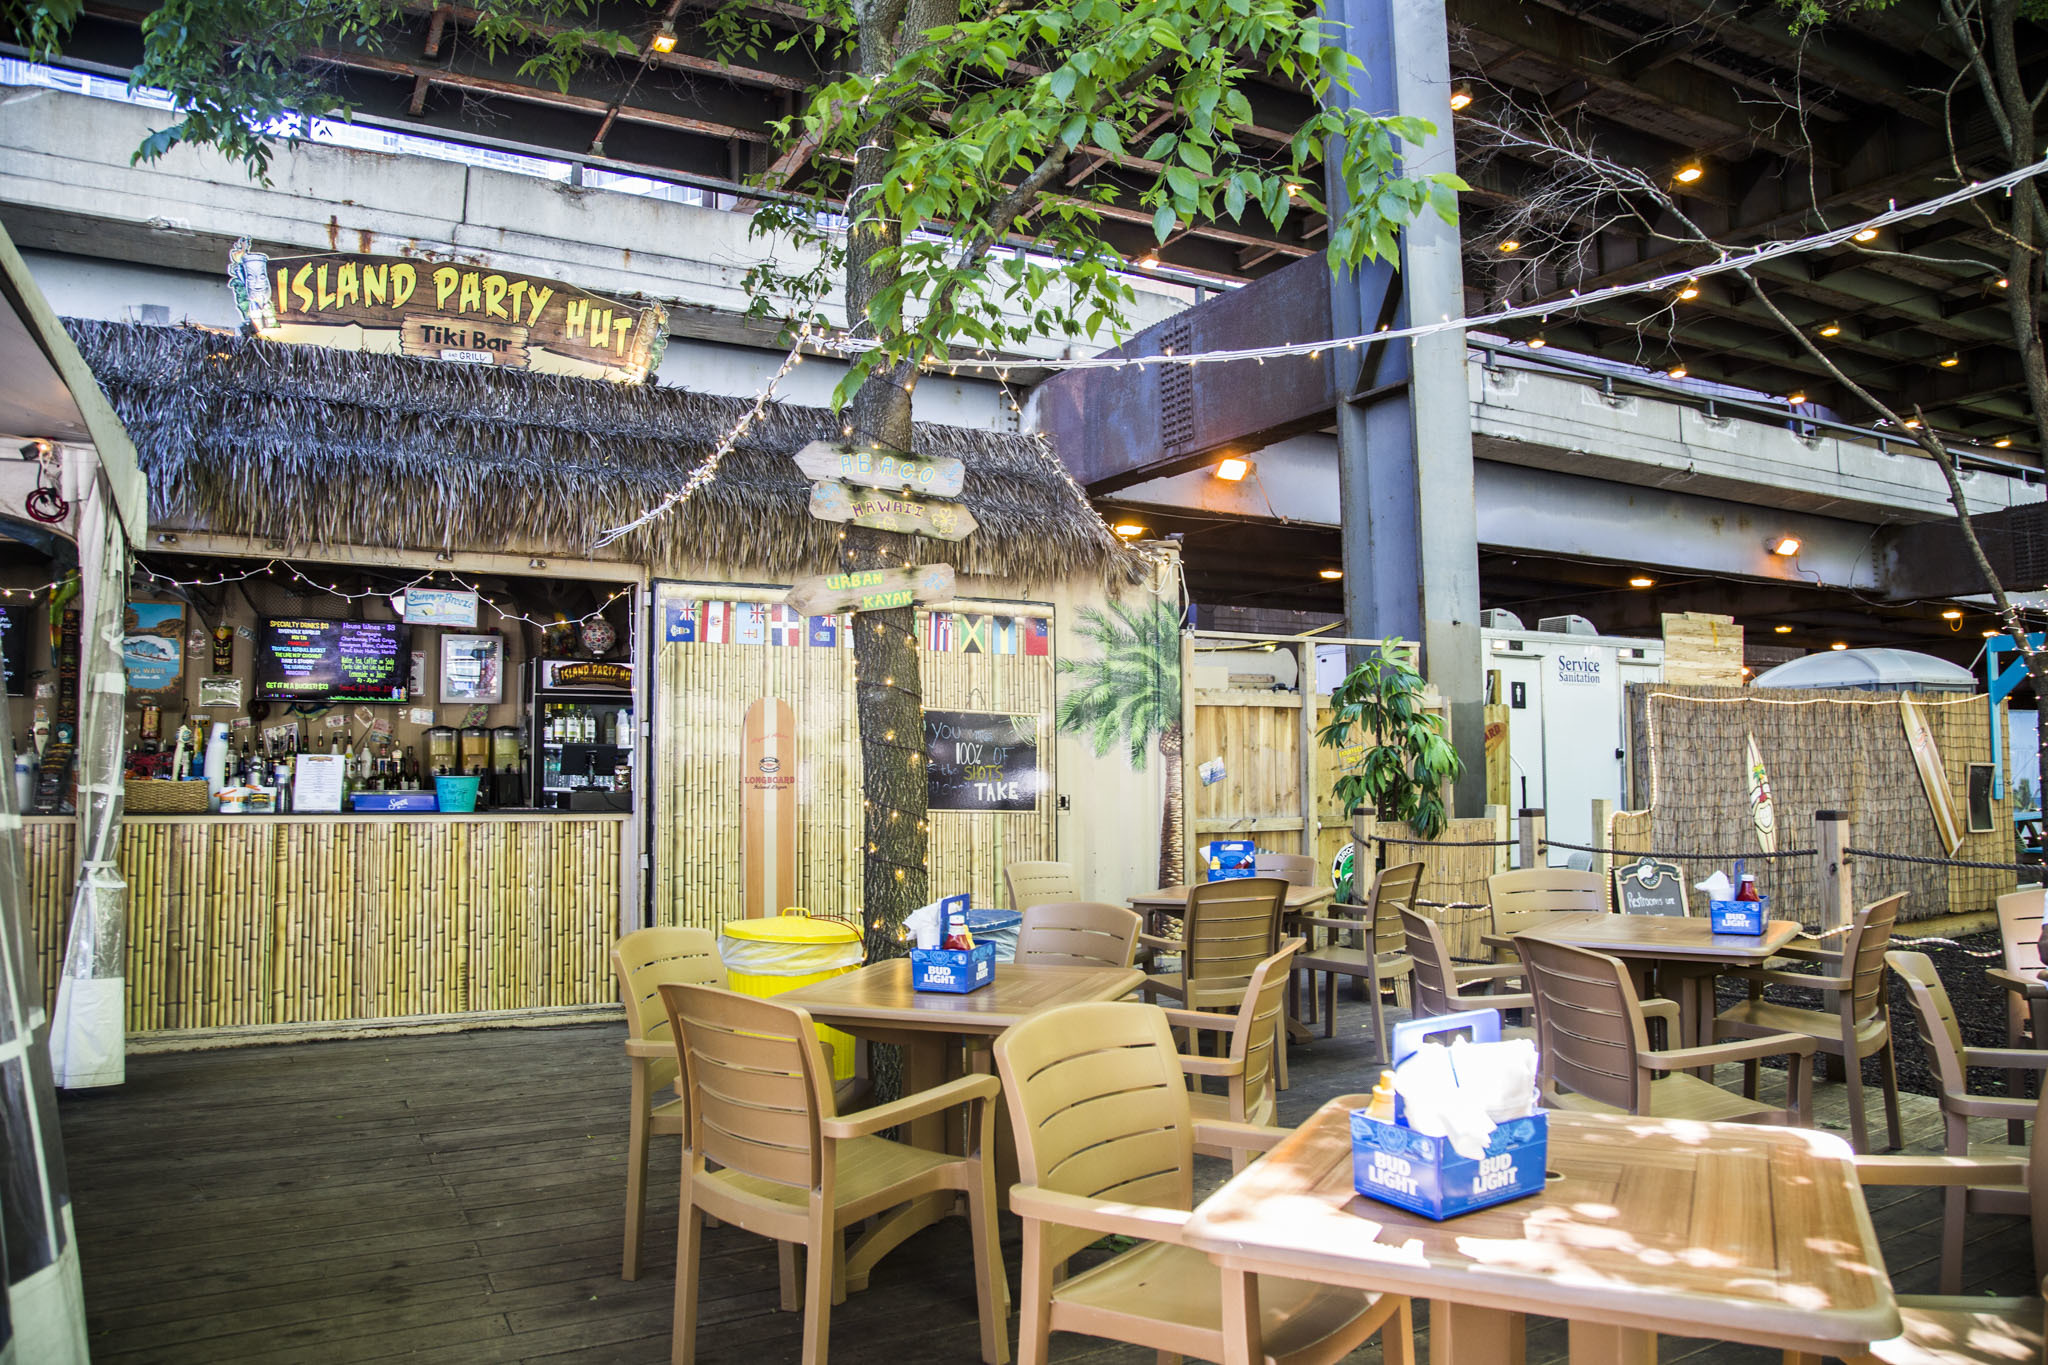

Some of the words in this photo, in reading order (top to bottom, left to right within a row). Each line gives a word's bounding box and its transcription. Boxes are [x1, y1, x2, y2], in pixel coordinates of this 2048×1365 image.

[277, 261, 417, 314] ISLAND
[433, 267, 555, 328] PARTY
[566, 299, 633, 358] HUT
[420, 325, 467, 347] Tiki
[473, 330, 513, 353] Bar
[460, 351, 485, 361] GRILL
[839, 453, 935, 484] ABACO
[852, 500, 926, 518] HAWAII
[826, 571, 883, 591] URBAN
[444, 592, 474, 608] Breeze
[862, 590, 913, 610] KAYAK
[269, 620, 299, 629] SPECIALTY
[300, 621, 320, 629] DRINKS
[342, 622, 361, 630] House
[362, 623, 381, 631] Wines
[560, 665, 589, 680] ISLAND
[592, 664, 618, 678] PARTY
[619, 669, 632, 681] HU
[1558, 655, 1600, 673] Service
[266, 681, 277, 689] GET
[289, 682, 294, 690] A
[1558, 671, 1601, 684] Sanitation
[956, 742, 983, 765] 100%
[744, 776, 795, 785] LONGBOARD
[963, 765, 1004, 782] SHOTS
[974, 781, 1019, 802] TAKE
[1627, 891, 1664, 909] Restrooms
[1665, 897, 1676, 905] are
[1721, 919, 1751, 928] LIGHT
[1725, 912, 1747, 921] BUD
[923, 973, 956, 985] LIGHT
[928, 965, 951, 976] BUD
[1373, 1150, 1412, 1178] BUD
[1478, 1152, 1513, 1177] BUD
[1368, 1164, 1419, 1197] LIGHT
[1472, 1167, 1519, 1195] LIGHT
